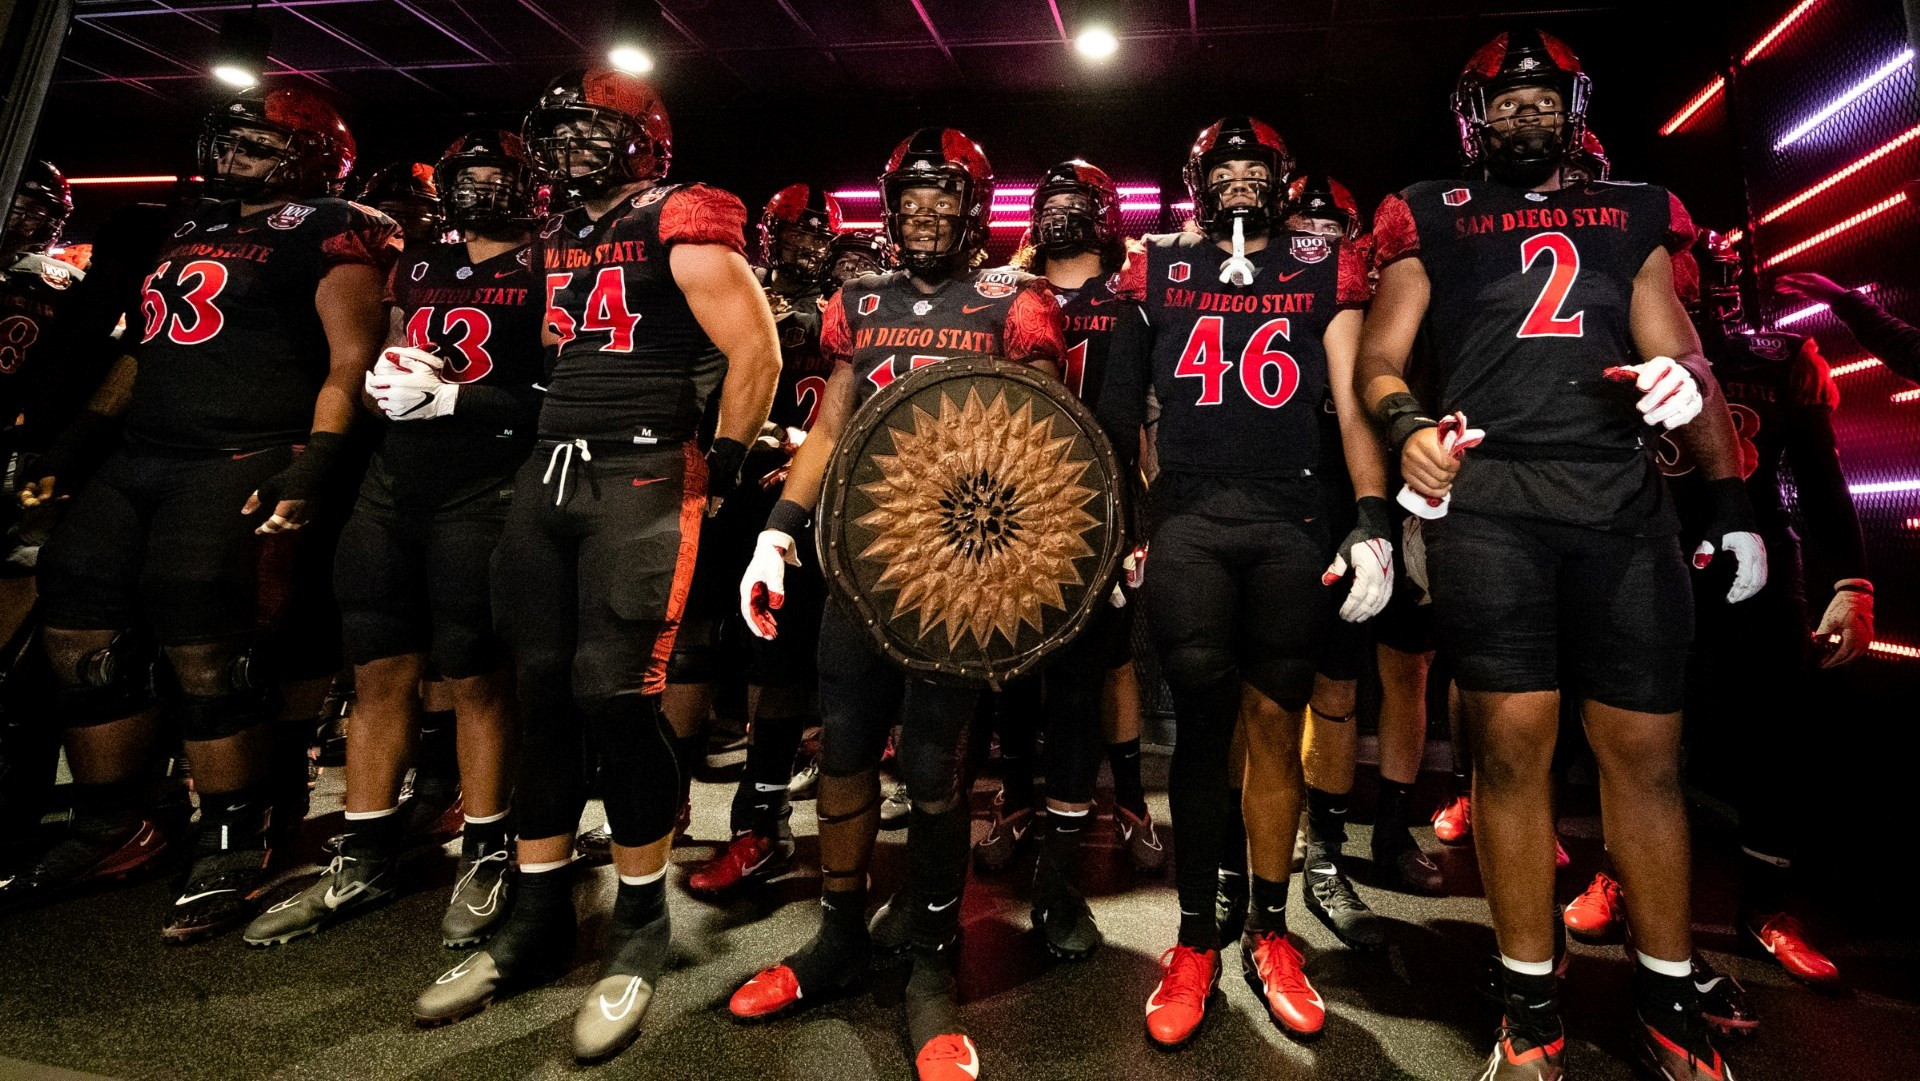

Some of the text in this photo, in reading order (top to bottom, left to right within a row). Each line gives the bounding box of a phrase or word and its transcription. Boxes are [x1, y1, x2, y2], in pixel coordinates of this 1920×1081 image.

[284, 206, 308, 217] 100
[1455, 207, 1630, 240] SAN DIEGO STATE
[593, 240, 648, 266] STATE
[1296, 238, 1323, 248] 100
[984, 274, 1013, 285] 100
[1516, 231, 1584, 338] 2
[470, 287, 528, 306] STATE
[1163, 287, 1316, 314] SAN DIEGO STATE
[546, 266, 642, 357] 54
[406, 306, 494, 384] 43
[874, 327, 934, 349] DIEGO
[935, 328, 996, 352] STATE
[1756, 338, 1782, 349] 100
[1174, 315, 1300, 409] 46
[641, 428, 653, 437] M
